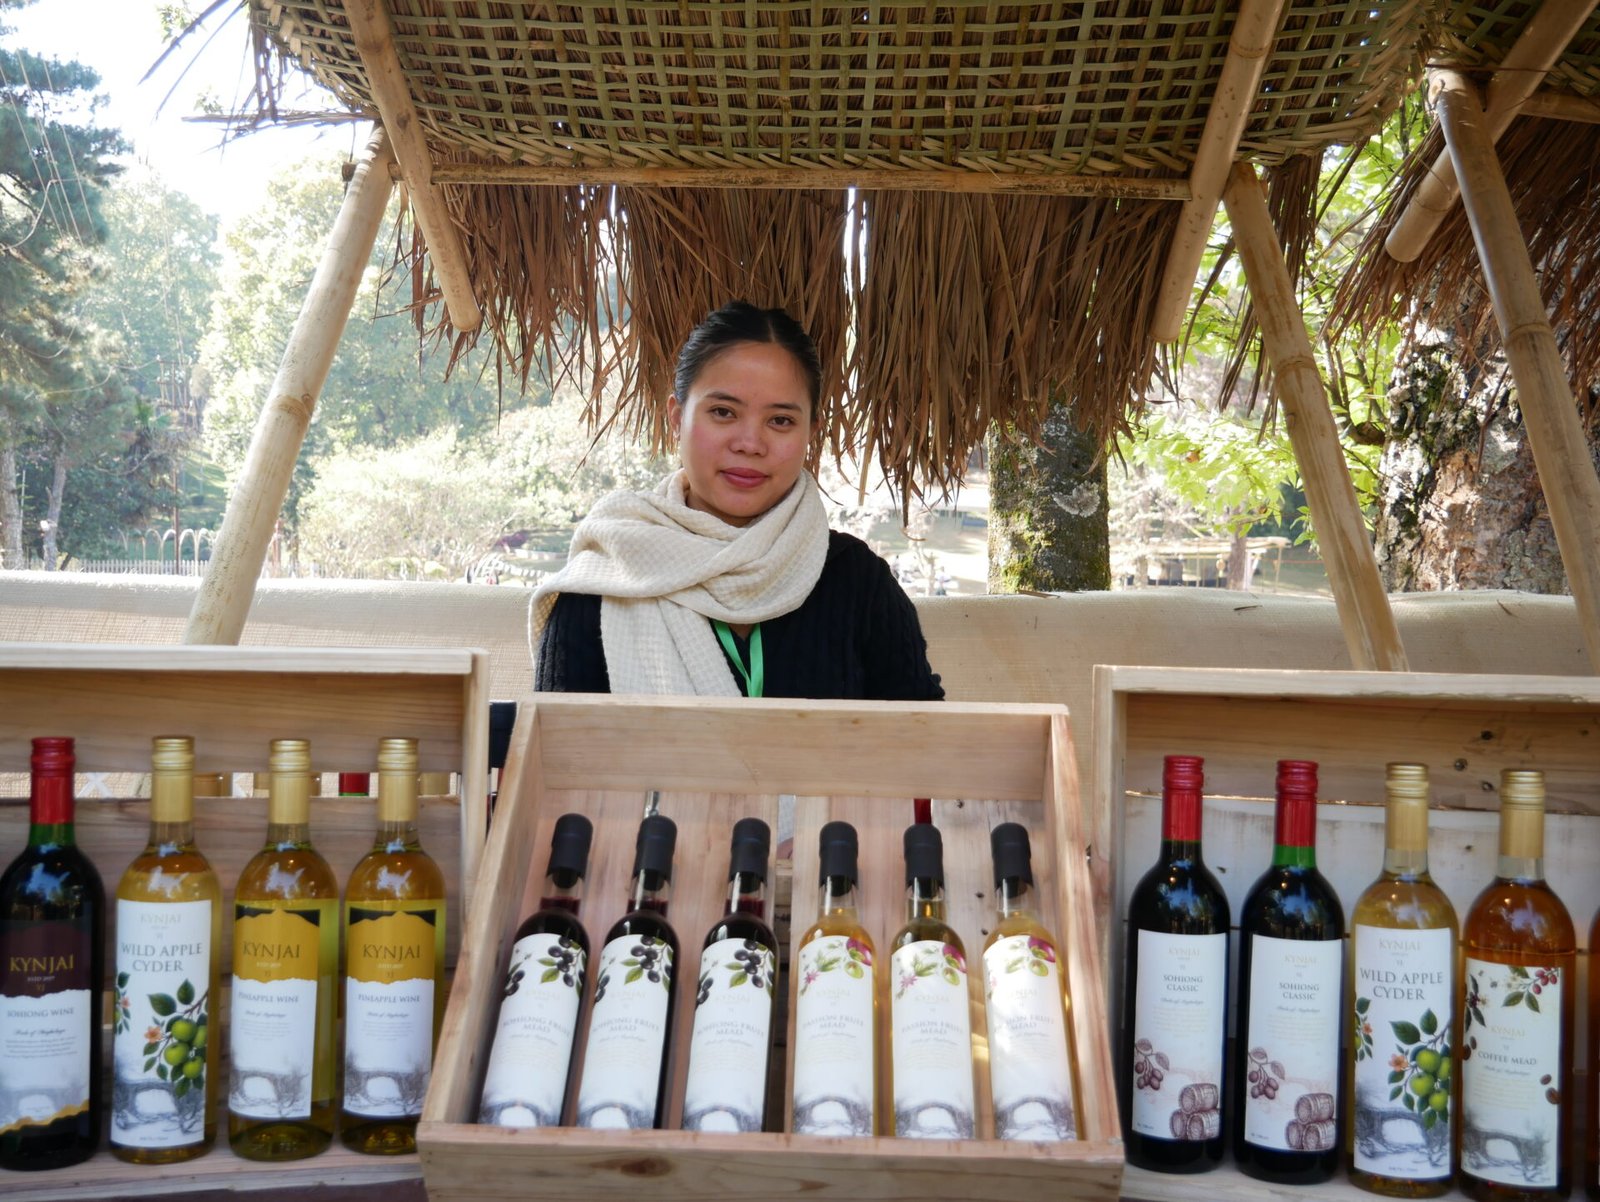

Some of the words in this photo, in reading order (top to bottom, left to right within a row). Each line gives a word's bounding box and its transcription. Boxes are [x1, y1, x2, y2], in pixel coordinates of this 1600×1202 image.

[120, 943, 156, 957] WILD
[160, 943, 203, 957] APPLE
[242, 941, 300, 960] KYNJAI
[362, 944, 421, 961] KYNJAI
[9, 954, 75, 974] KYNJAI
[132, 959, 184, 973] CYDER
[1163, 974, 1204, 984] SOHIONG
[1359, 967, 1397, 983] WILD
[1400, 971, 1444, 985] APPLE
[1166, 984, 1200, 993] CLASSIC
[1279, 982, 1320, 992] SOHIONG
[1282, 991, 1317, 1001] CLASSIC
[1372, 985, 1425, 1000] CYDER
[276, 995, 299, 1003] WINE
[358, 993, 397, 1004] PINEAPPLE
[399, 995, 421, 1003] WINE
[51, 1007, 75, 1016] WINE
[522, 1023, 551, 1034] MEAD
[609, 1024, 638, 1033] MEAD
[819, 1021, 847, 1030] MEAD
[716, 1028, 744, 1036] MEAD
[920, 1027, 948, 1035] MEAD
[1477, 1050, 1509, 1063] COFFEE
[1510, 1057, 1537, 1066] MEAD
